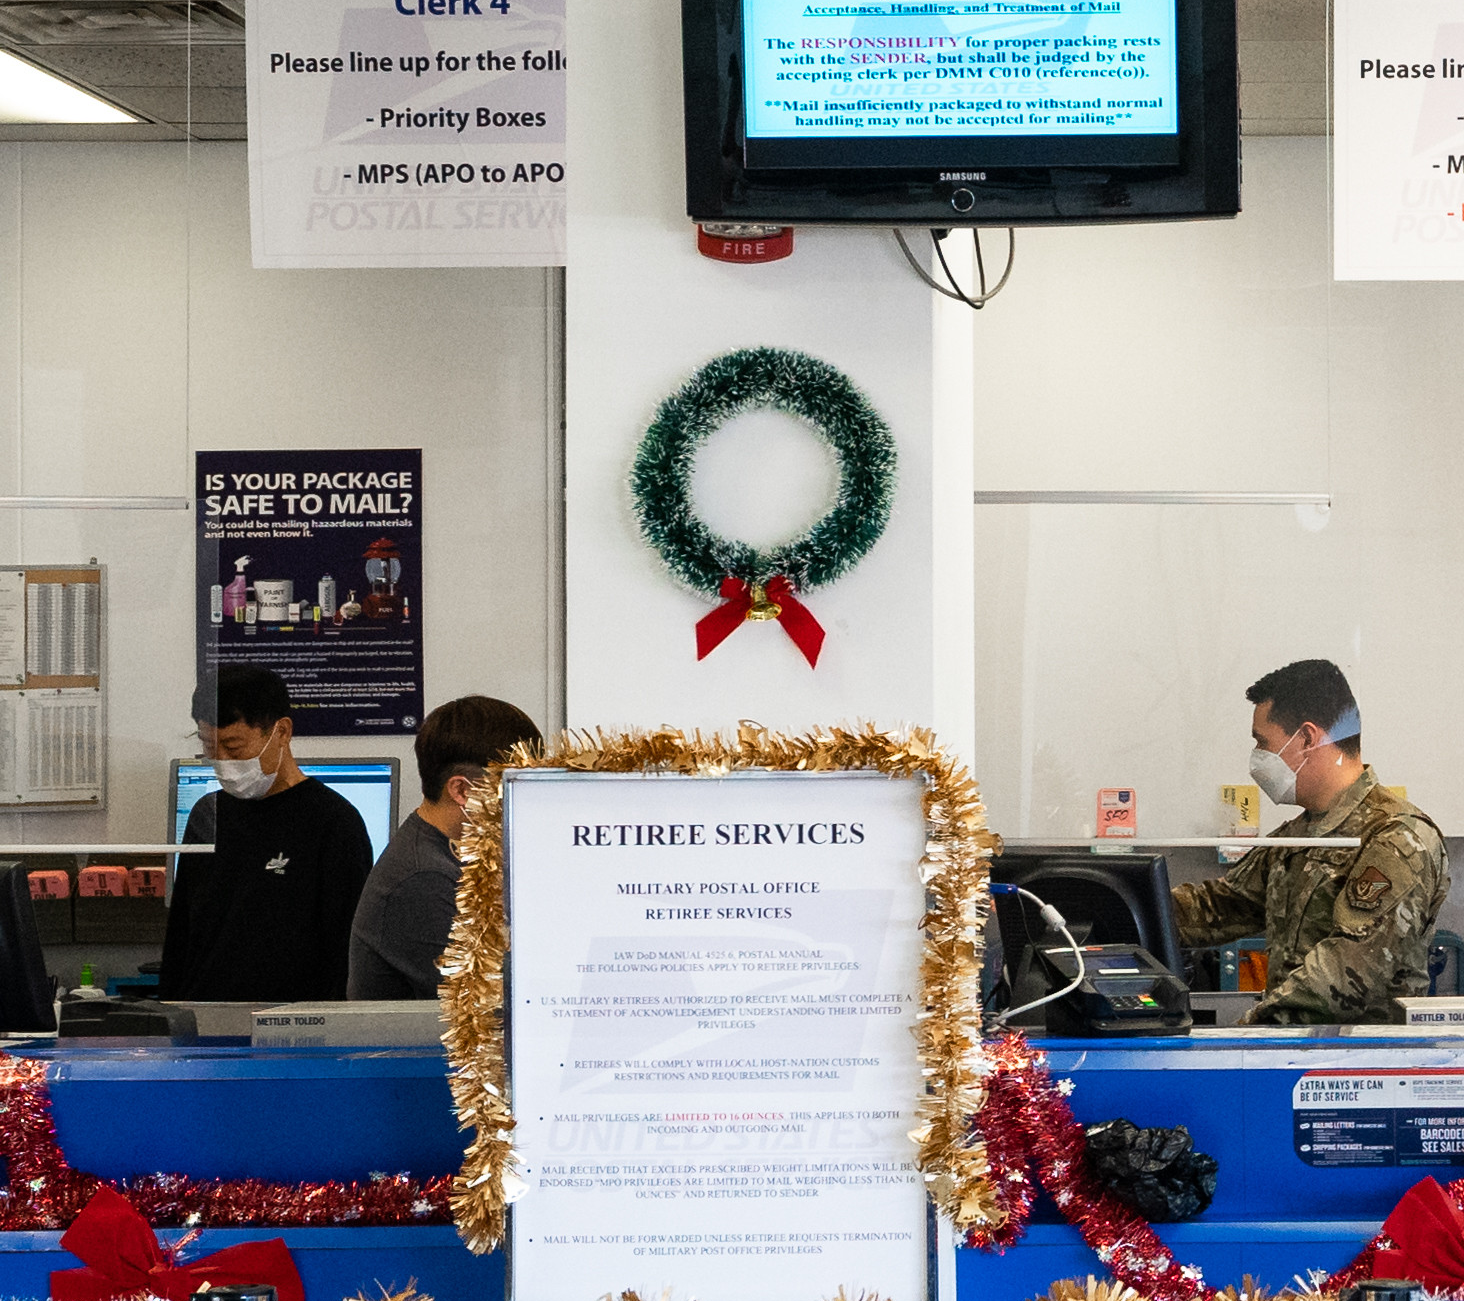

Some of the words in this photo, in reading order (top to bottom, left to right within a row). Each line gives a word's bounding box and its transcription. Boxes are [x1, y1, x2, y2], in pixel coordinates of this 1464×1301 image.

[270, 52, 344, 74] Please
[349, 51, 394, 73] line
[399, 56, 430, 78] up
[435, 50, 471, 72] for
[475, 50, 516, 71] the
[1360, 58, 1436, 79] Please
[380, 106, 470, 134] Priority
[476, 107, 547, 128] Boxes
[358, 163, 410, 185] MPS
[415, 163, 475, 187] (APO
[480, 165, 506, 183] to
[939, 171, 987, 182] SAMSUNG
[722, 242, 766, 256] FIRE
[205, 473, 225, 491] IS
[231, 472, 297, 491] YOUR
[303, 471, 413, 490] PACKAGE
[205, 494, 275, 517] SAFE
[281, 493, 323, 515] TO
[329, 492, 413, 515] MAIL?
[573, 824, 706, 847] RETIREE
[715, 822, 865, 845] SERVICES
[617, 882, 692, 895] MILITARY
[699, 882, 756, 895] POSTAL
[763, 881, 817, 894] OFFICE
[645, 908, 710, 920] RETIREE
[716, 907, 793, 919] SERVICES
[256, 1016, 292, 1027] METTLER
[293, 1016, 326, 1026] TOLEDO
[1410, 1013, 1446, 1023] METTLER
